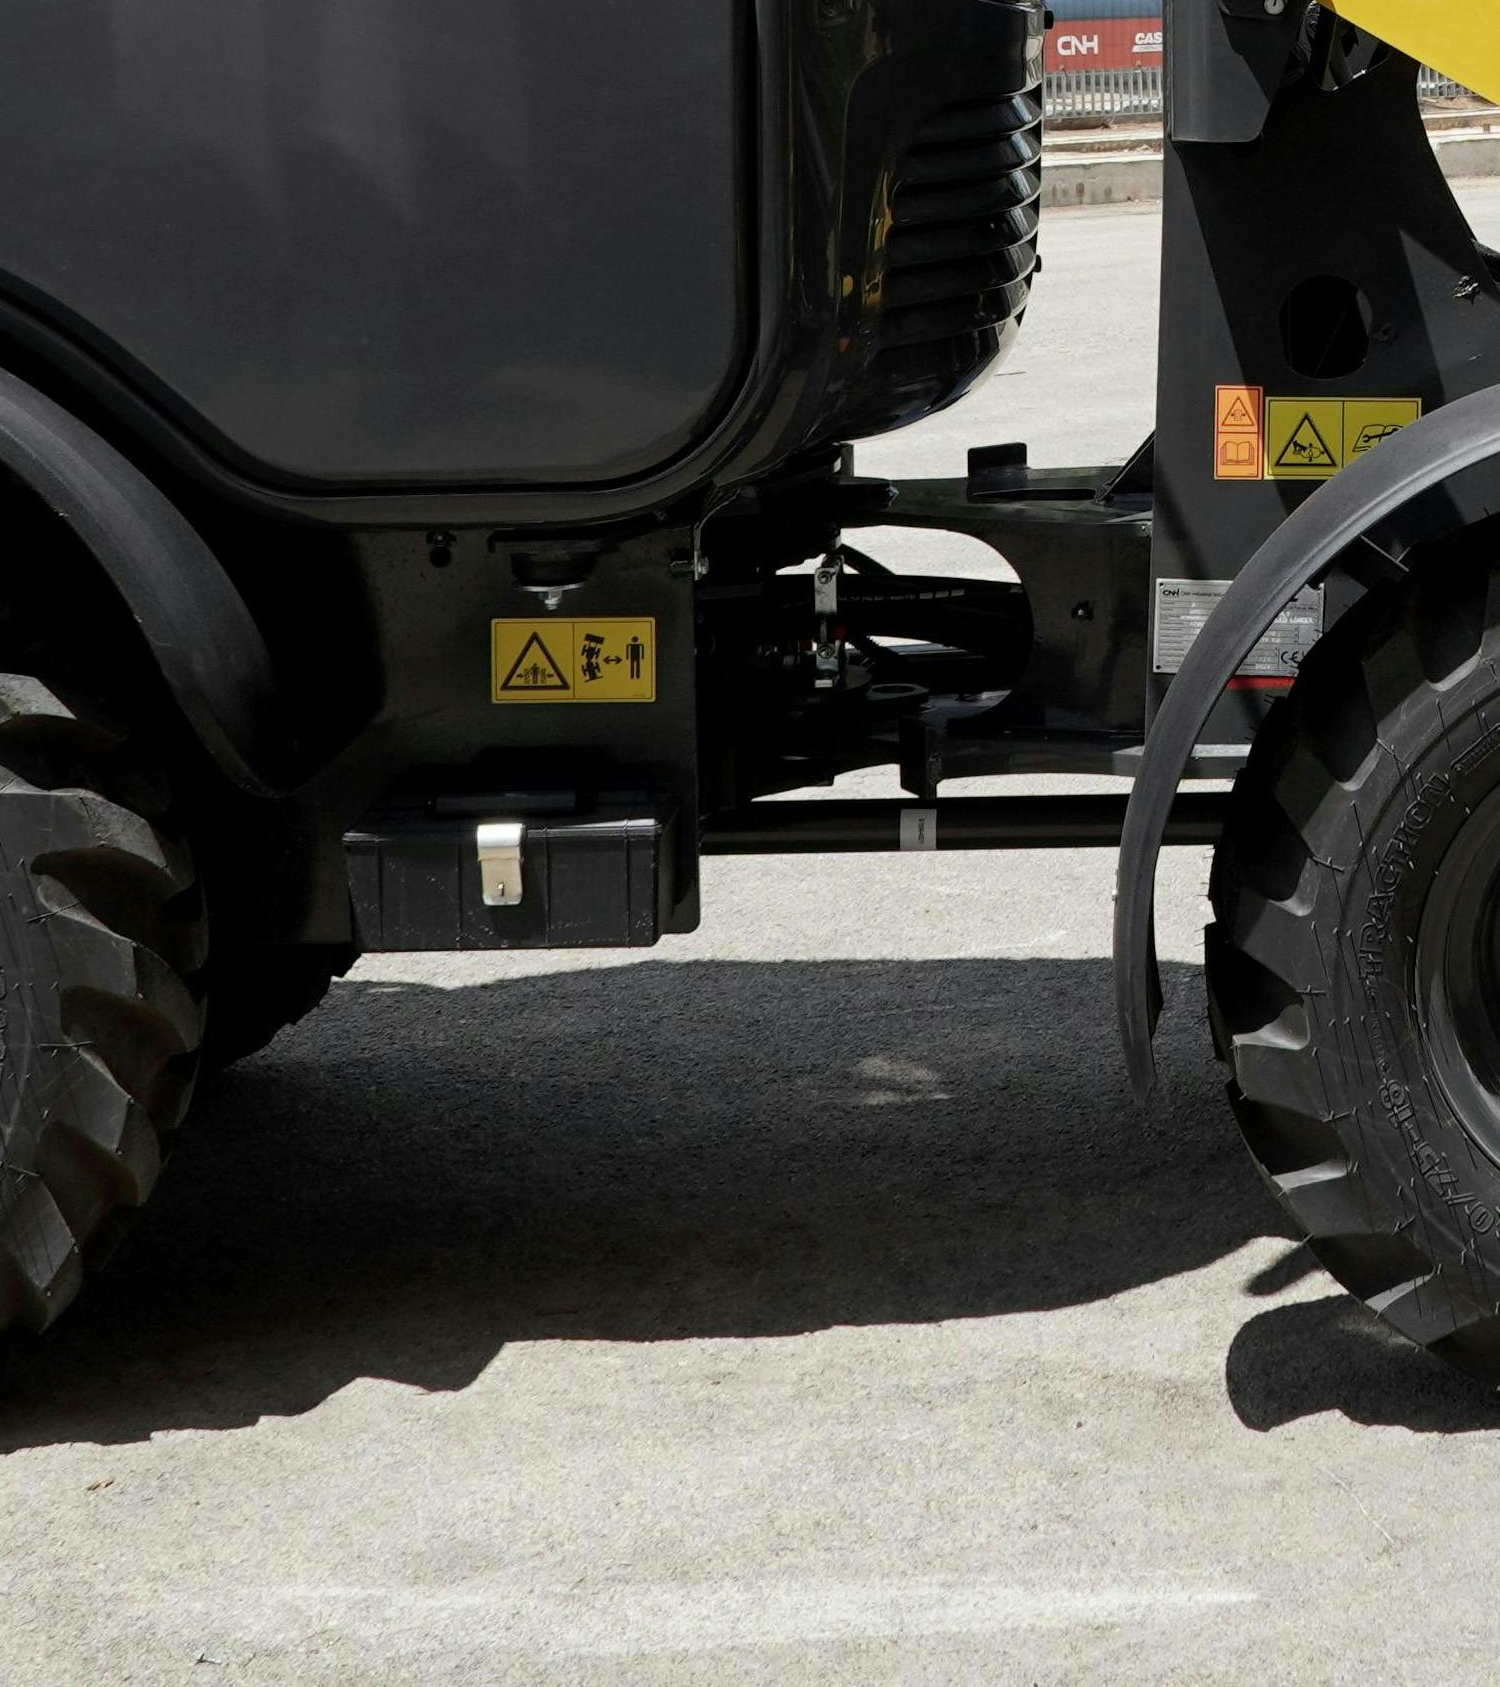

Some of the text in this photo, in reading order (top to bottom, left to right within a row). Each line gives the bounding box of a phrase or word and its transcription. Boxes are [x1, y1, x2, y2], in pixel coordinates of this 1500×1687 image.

[1056, 34, 1099, 56] CNH
[1135, 32, 1163, 44] CAS
[1357, 772, 1453, 980] TRACTION
